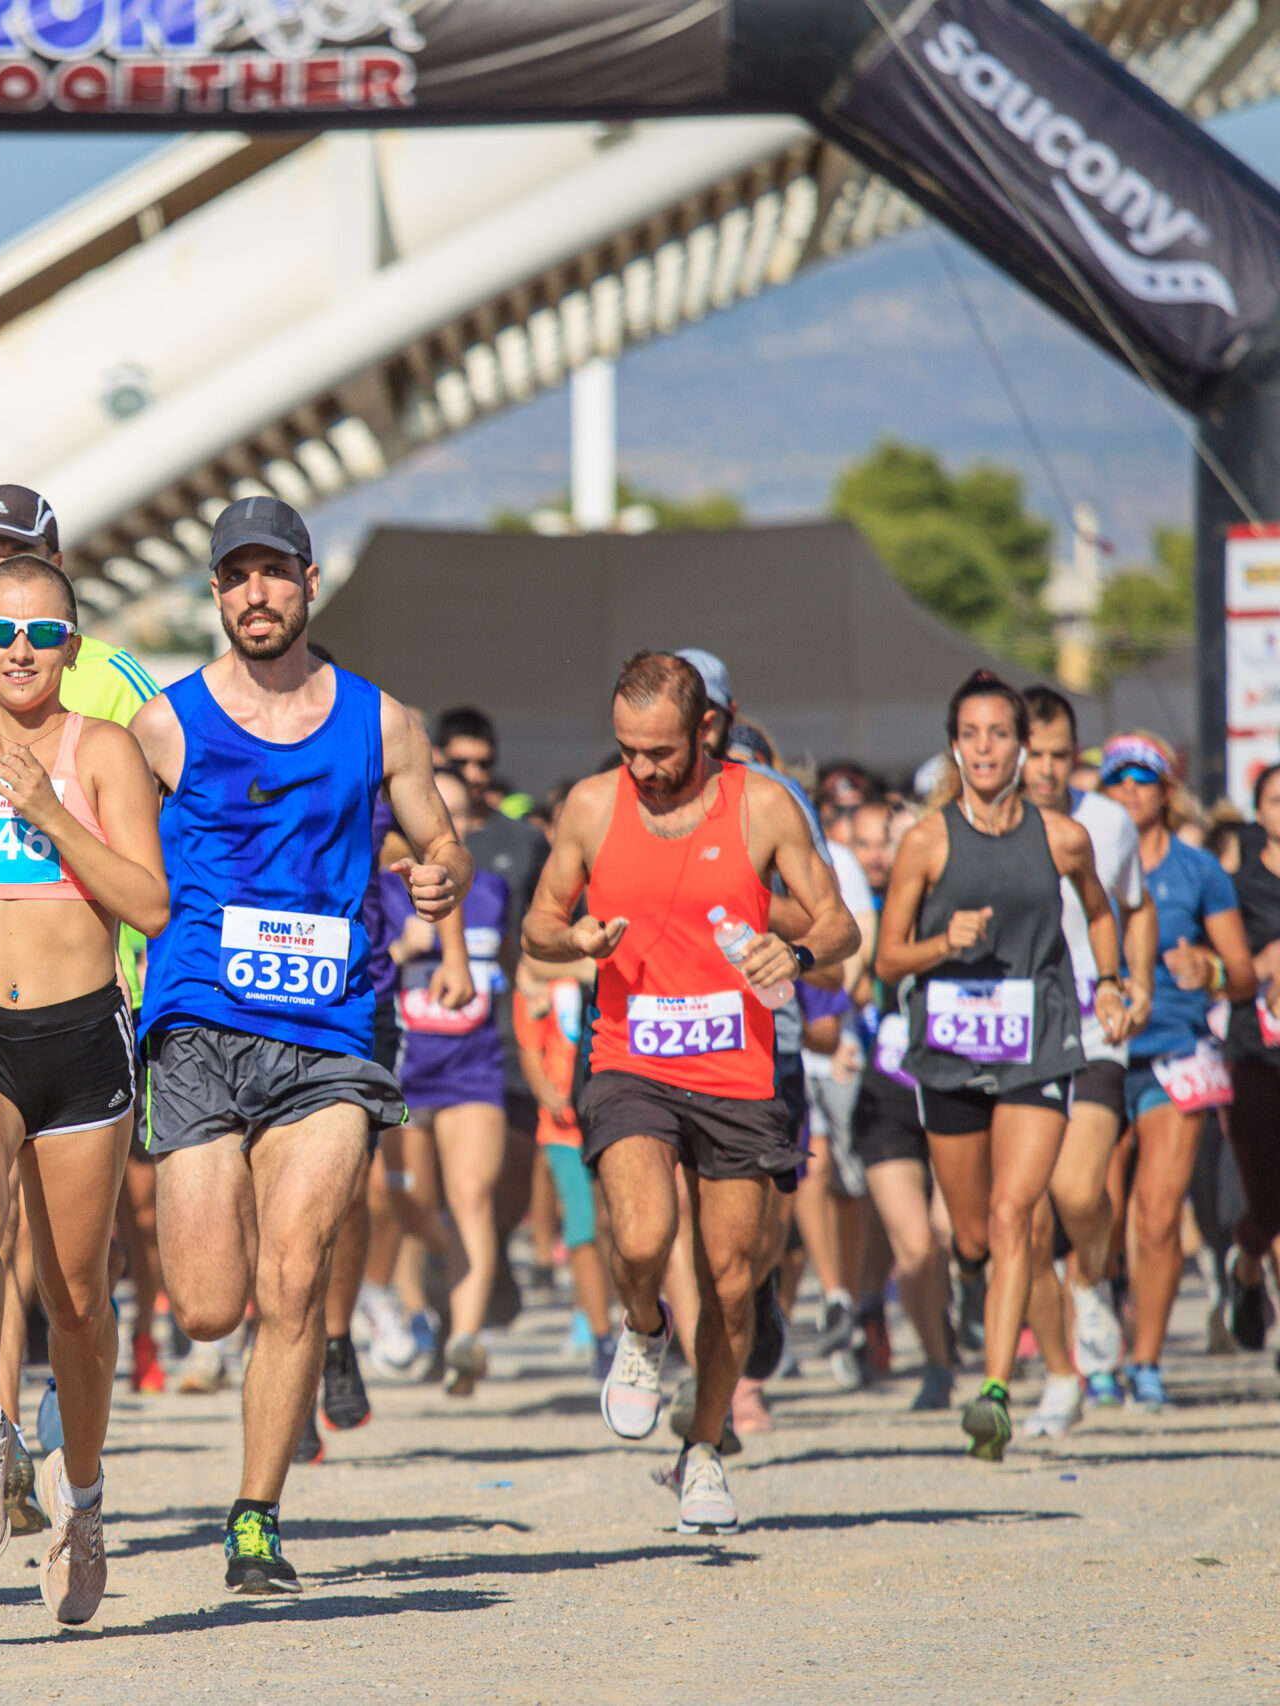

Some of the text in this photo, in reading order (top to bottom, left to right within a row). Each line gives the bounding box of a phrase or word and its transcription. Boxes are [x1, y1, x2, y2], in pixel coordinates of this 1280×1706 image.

[923, 21, 1197, 256] saucony
[258, 920, 291, 935] RUN
[258, 933, 314, 947] TOGETHER
[227, 951, 337, 996] 6330
[634, 1016, 735, 1055] 6242
[932, 1014, 1025, 1047] 6218
